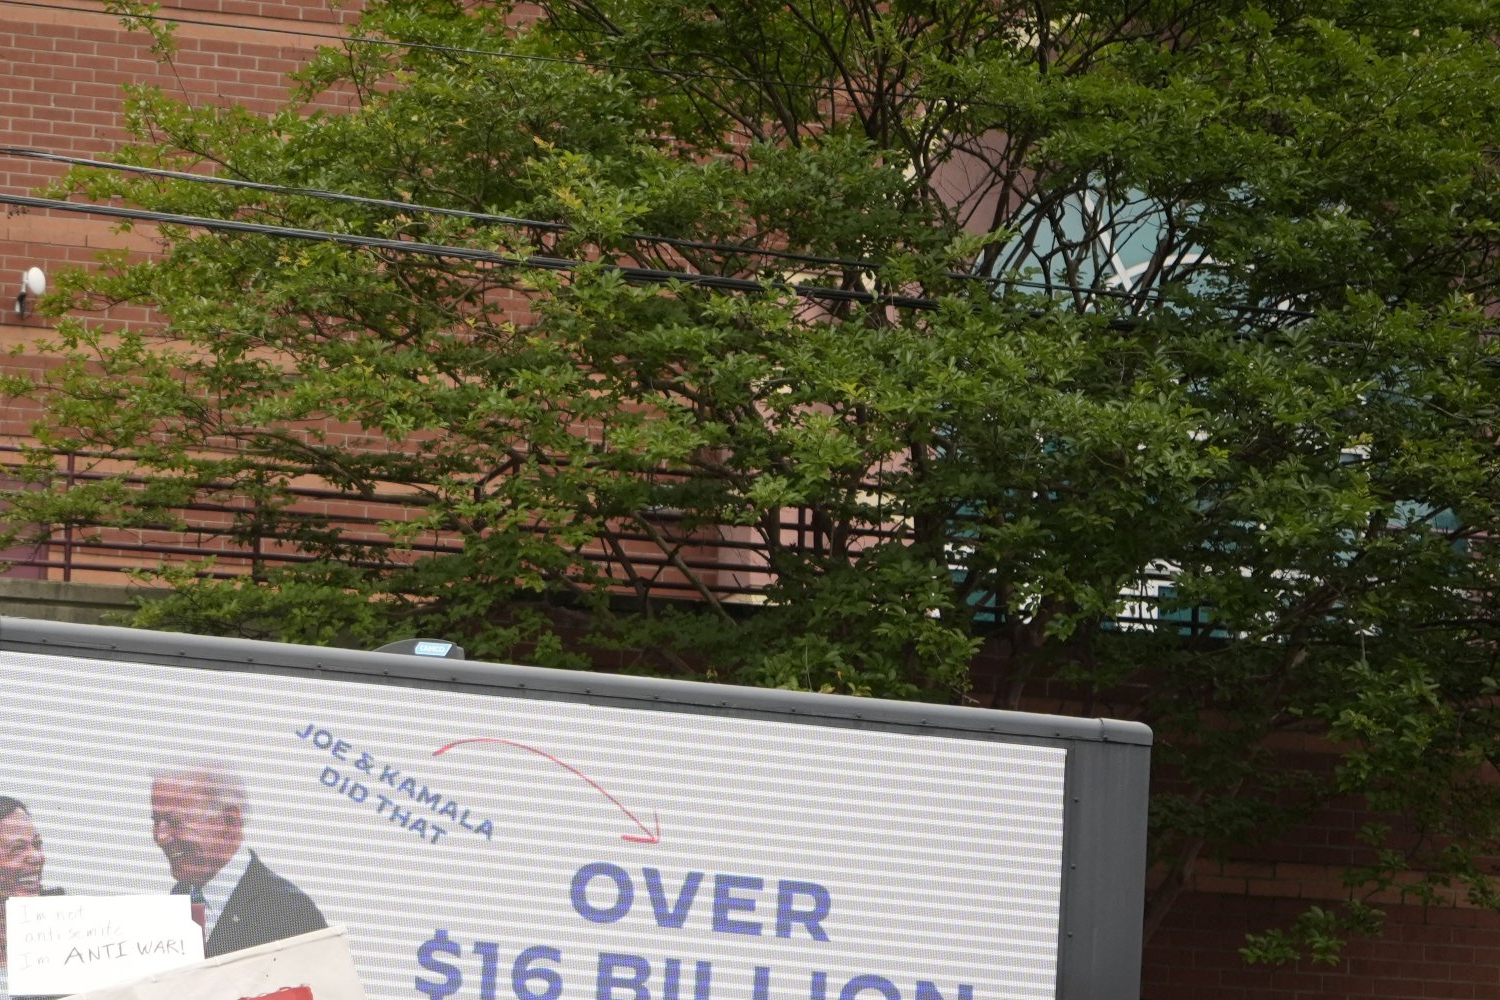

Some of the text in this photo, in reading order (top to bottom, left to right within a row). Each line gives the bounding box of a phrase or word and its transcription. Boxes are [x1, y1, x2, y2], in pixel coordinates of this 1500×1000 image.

[295, 724, 495, 841] JOE & KAMALA
[319, 766, 448, 845] DID THAT
[56, 905, 85, 921] not
[569, 861, 832, 943] OVER
[63, 940, 128, 966] ANTI
[136, 939, 186, 956] WAR!
